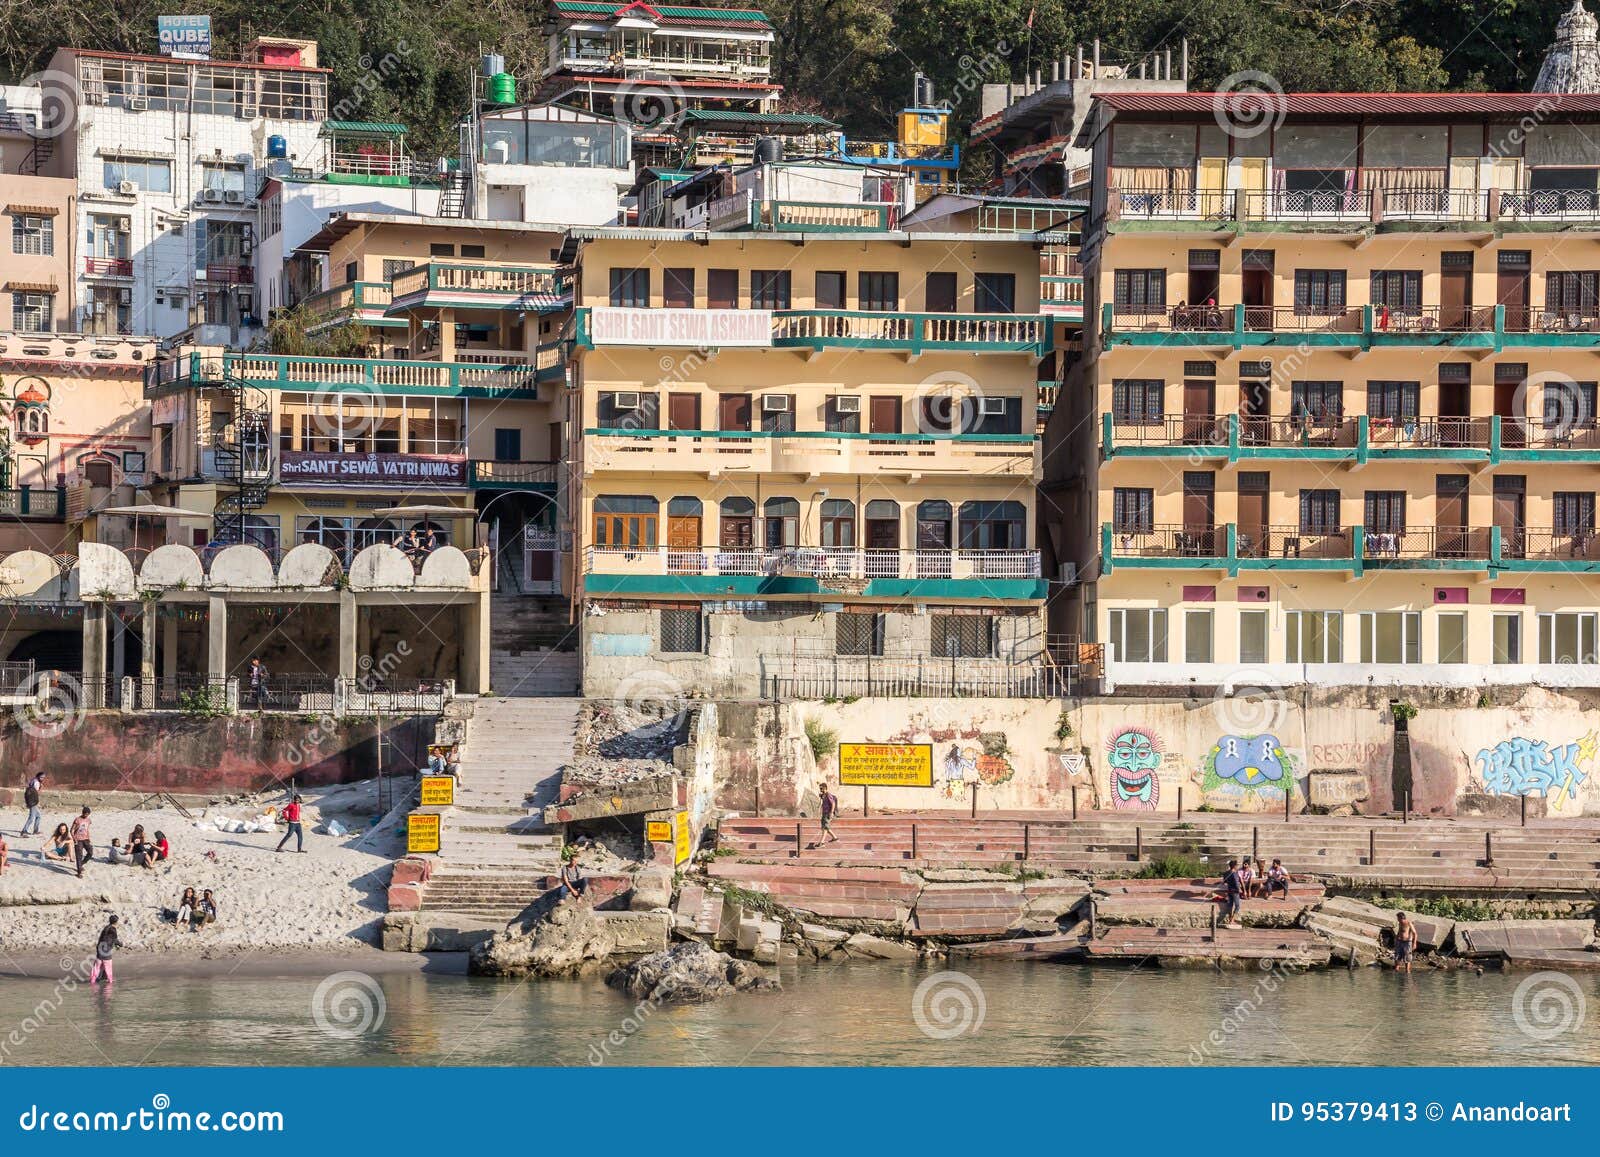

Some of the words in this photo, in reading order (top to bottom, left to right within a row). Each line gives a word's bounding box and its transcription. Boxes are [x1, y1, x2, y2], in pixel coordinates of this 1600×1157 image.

[163, 17, 204, 27] HOTEL
[159, 29, 209, 43] QUBE
[595, 311, 628, 338] SHRI
[631, 312, 666, 340] SANT
[669, 313, 708, 341] SEWA
[711, 314, 768, 341] ASHRAM
[282, 463, 301, 473] Shri
[301, 460, 339, 473] SANT
[340, 460, 379, 475] SEWA
[420, 462, 459, 477] NIWAS
